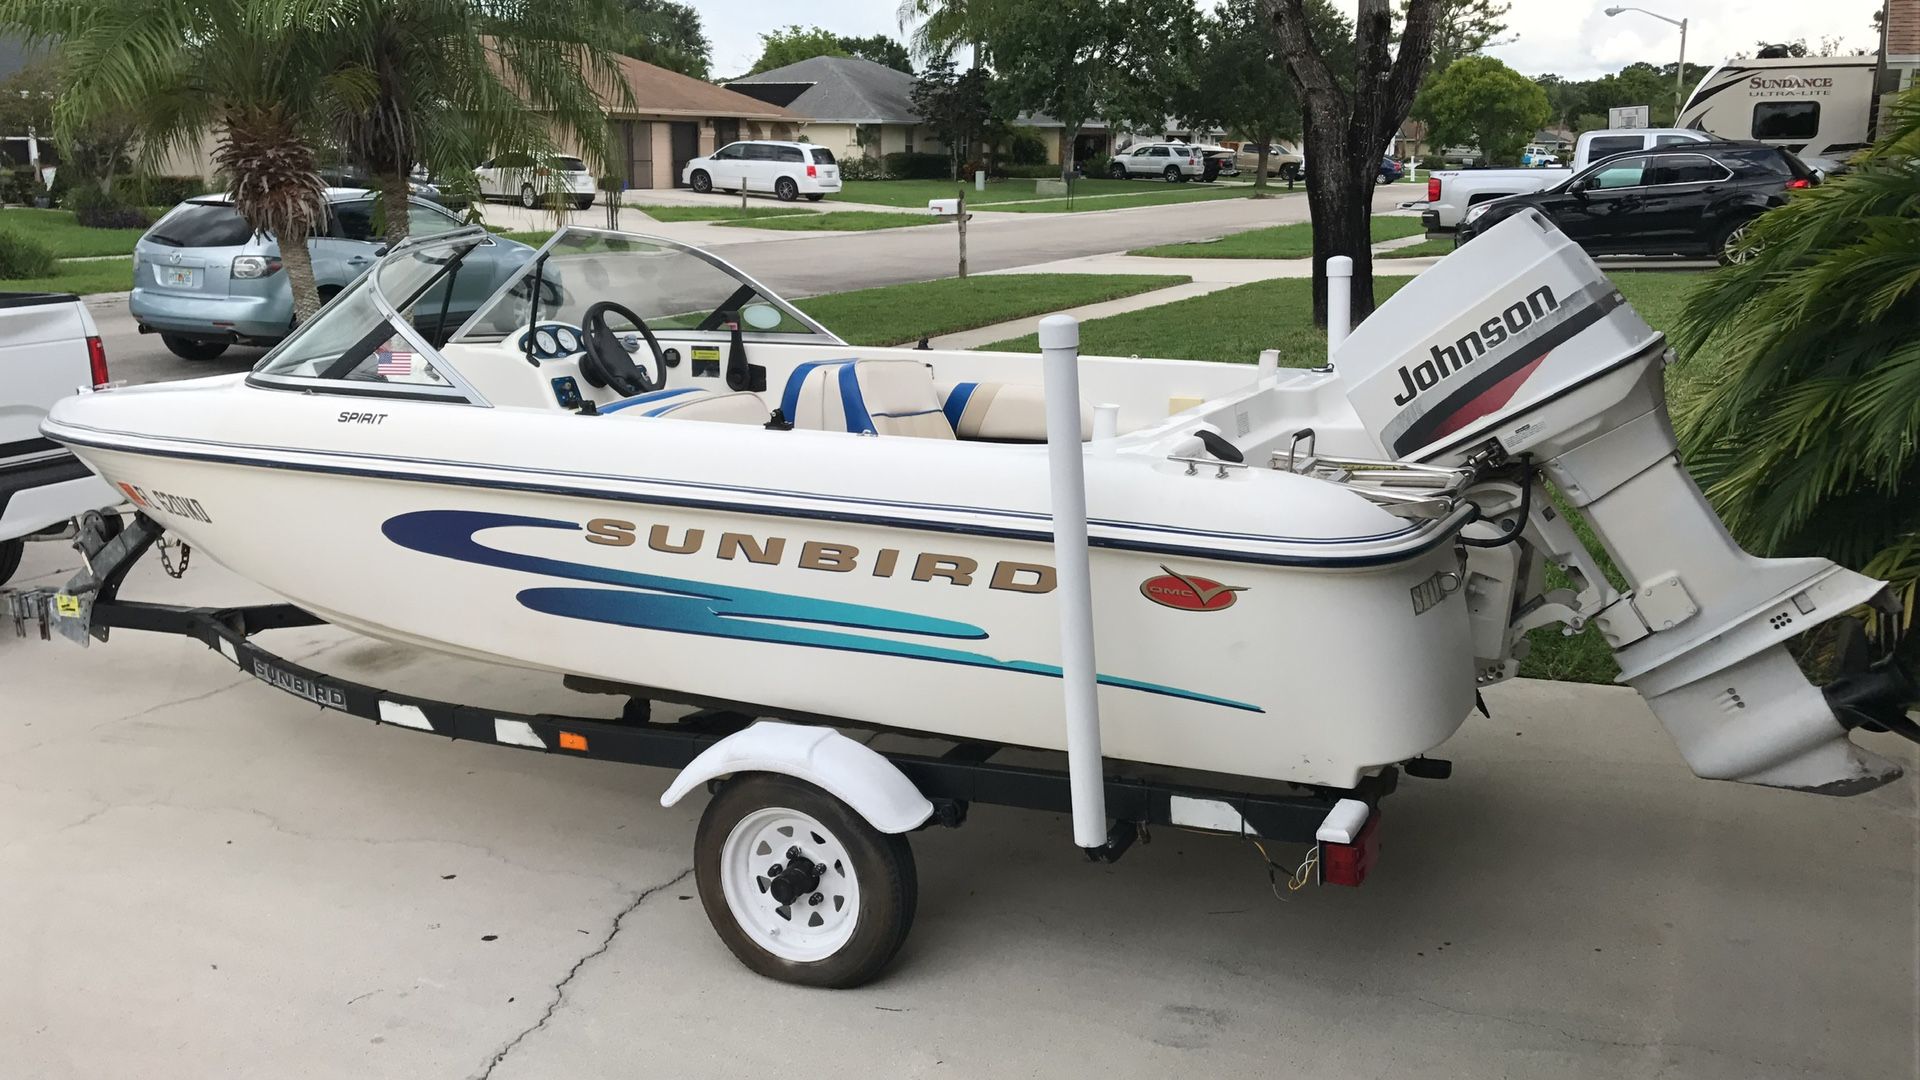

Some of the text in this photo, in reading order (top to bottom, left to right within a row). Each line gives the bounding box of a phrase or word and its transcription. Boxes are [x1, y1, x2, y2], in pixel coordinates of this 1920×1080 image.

[1394, 285, 1558, 407] Johnson
[337, 411, 388, 425] SPIRIT
[585, 518, 1058, 594] SUNBIRD
[1149, 586, 1193, 597] OMC
[255, 660, 346, 706] SUNBIRD
